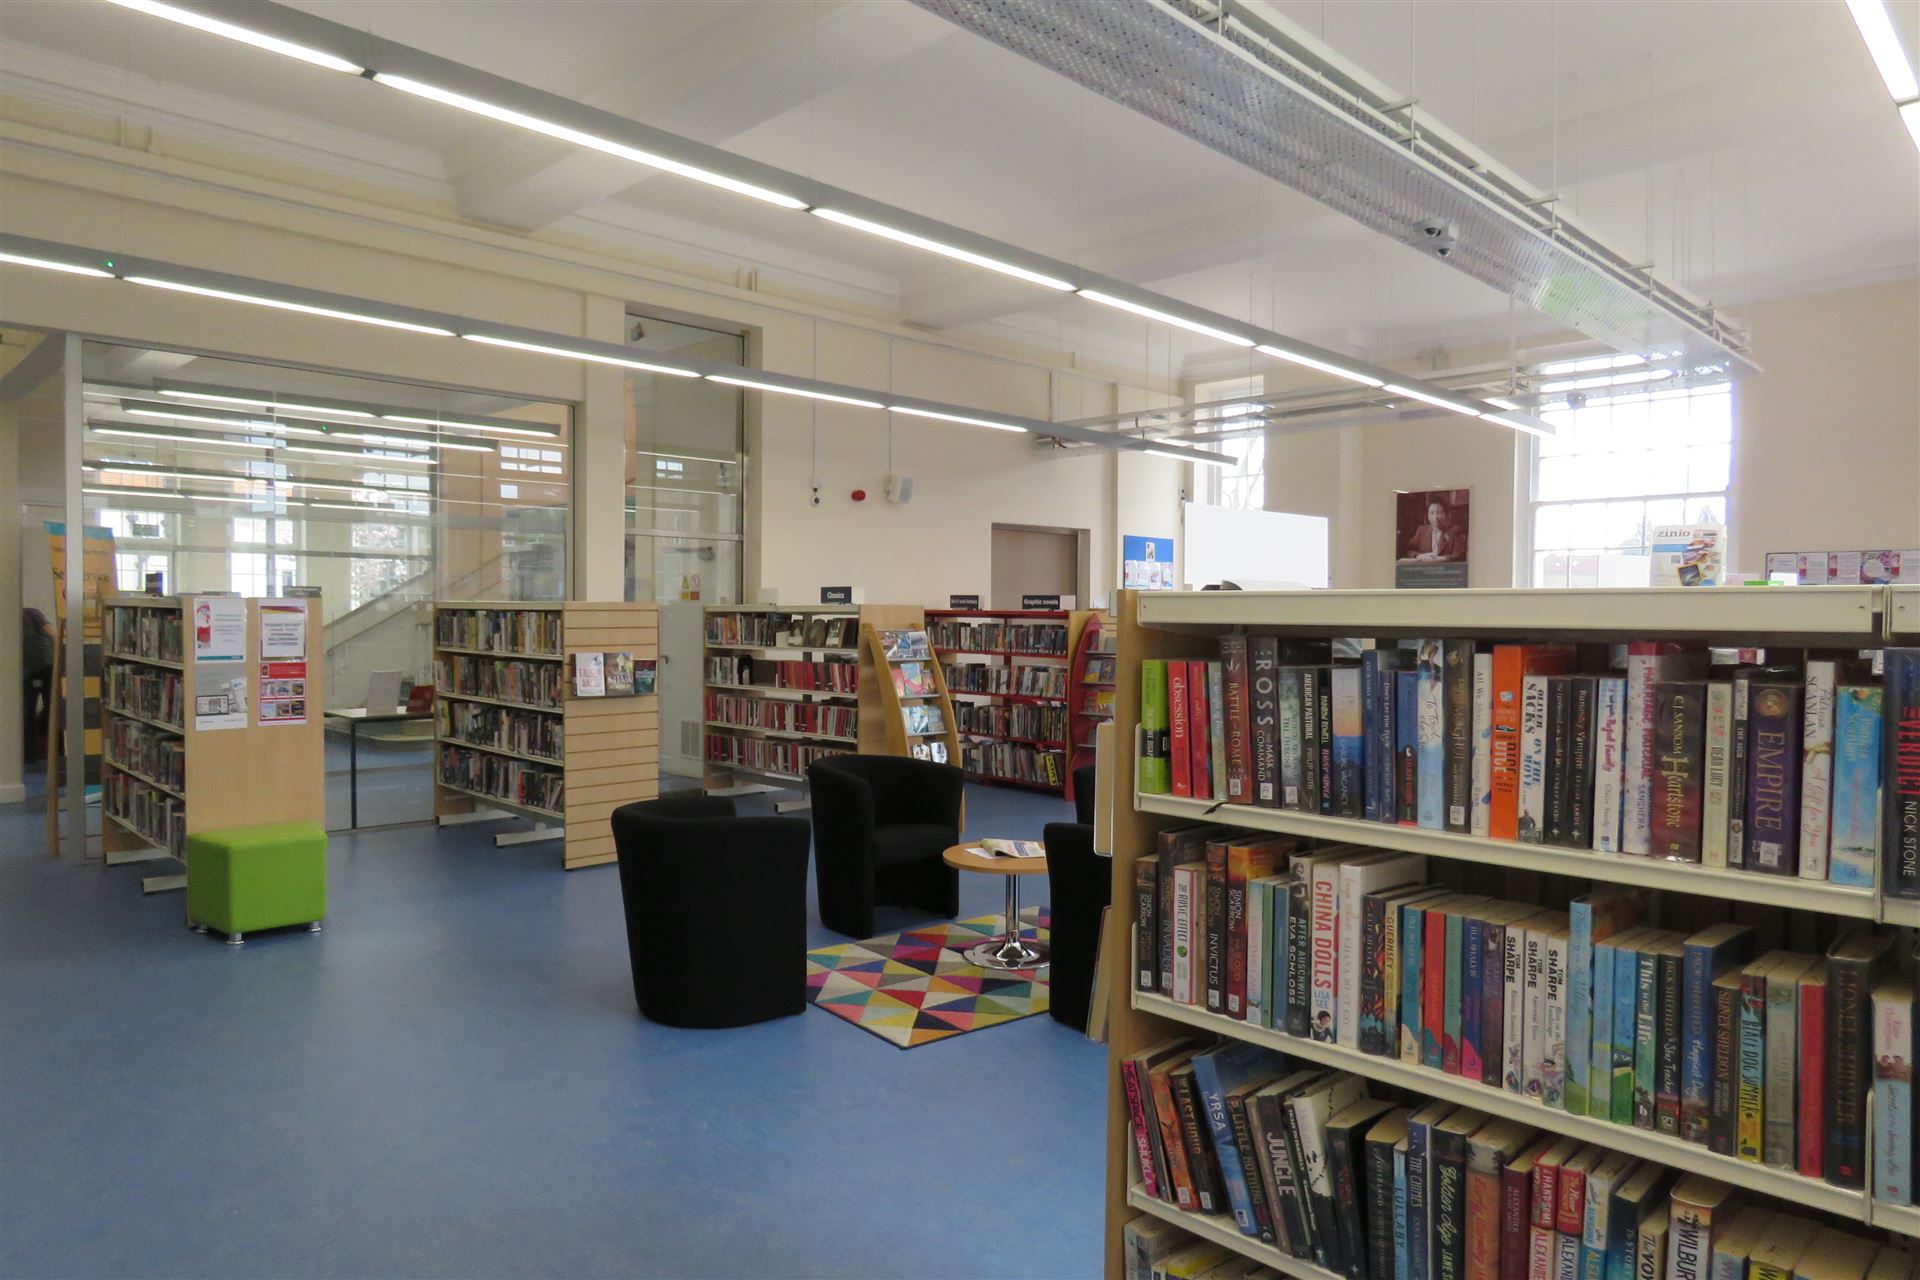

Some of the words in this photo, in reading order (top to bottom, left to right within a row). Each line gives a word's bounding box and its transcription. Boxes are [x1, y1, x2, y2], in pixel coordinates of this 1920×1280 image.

[1173, 677, 1186, 738] obsession
[1228, 682, 1240, 721] BATTLE
[1255, 659, 1274, 726] ROSS
[1304, 673, 1312, 707] AMERICAN
[1525, 682, 1536, 735] SACKS
[1536, 689, 1544, 729] OLIVER
[1642, 666, 1655, 723] MARRIAGE
[1805, 675, 1816, 739] SCANLAN
[1304, 707, 1313, 740] PASTORAL
[1673, 712, 1682, 754] SANSOM
[1231, 731, 1242, 765] ROME
[1257, 730, 1265, 781] COMMAND
[1266, 744, 1274, 769] MASK
[1533, 738, 1541, 755] ON
[1575, 731, 1586, 769] Vampire
[1641, 728, 1654, 780] MATERIAL
[1710, 747, 1724, 766] DEAR
[1897, 719, 1920, 795] VERDICT
[1523, 753, 1533, 786] MOVE
[1532, 759, 1541, 785] THE
[1710, 768, 1723, 787] LUCY
[1755, 730, 1784, 831] EMPIRE
[1637, 783, 1646, 830] SANGHERA
[1661, 755, 1689, 828] Heartstone
[1904, 801, 1917, 832] NICK
[1903, 836, 1917, 876] STONE
[1315, 881, 1333, 931] CHINA
[1177, 918, 1188, 942] EFFECT
[1297, 918, 1306, 947] AFTER
[1386, 916, 1394, 970] GUERNSEY
[1209, 933, 1218, 984] INVICTUS
[1287, 944, 1296, 1005] SCHLOSS
[1296, 950, 1307, 1007] AUSCHWITZ
[1314, 937, 1332, 989] DOLLS
[1506, 936, 1516, 983] SHARPE
[1527, 940, 1538, 988] SHARPE
[1547, 949, 1557, 1001] SHARPE
[1640, 959, 1654, 990] This
[1664, 986, 1674, 1035] SHEFFIELD
[1717, 990, 1730, 1029] SIDNEY
[1838, 969, 1857, 1038] LIONEL
[1638, 1013, 1653, 1045] Life
[1664, 1043, 1675, 1062] Star
[1688, 1039, 1703, 1077] Happiest
[1717, 1030, 1729, 1079] SHELDON
[1743, 1050, 1760, 1072] DOG
[1664, 1064, 1676, 1094] Teacher
[1741, 1074, 1761, 1113] SUMMER
[1124, 1064, 1144, 1131] MEATSPACE
[1137, 1136, 1153, 1186] SHUKLA
[1179, 1089, 1194, 1120] LAST
[1209, 1092, 1227, 1131] YRSA
[1232, 1113, 1250, 1152] LITTLE
[1242, 1156, 1263, 1205] NOTHING
[1266, 1132, 1296, 1198] JUNGLE
[1410, 1157, 1422, 1173] THE
[1411, 1175, 1422, 1208] CHIMES
[1439, 1165, 1457, 1212] Golden
[1542, 1175, 1552, 1225] HANDSOME
[1395, 1187, 1406, 1249] LULLABY
[1436, 1214, 1457, 1246] Age
[1441, 1248, 1453, 1270] JANE
[1676, 1229, 1698, 1280] WILBUR
